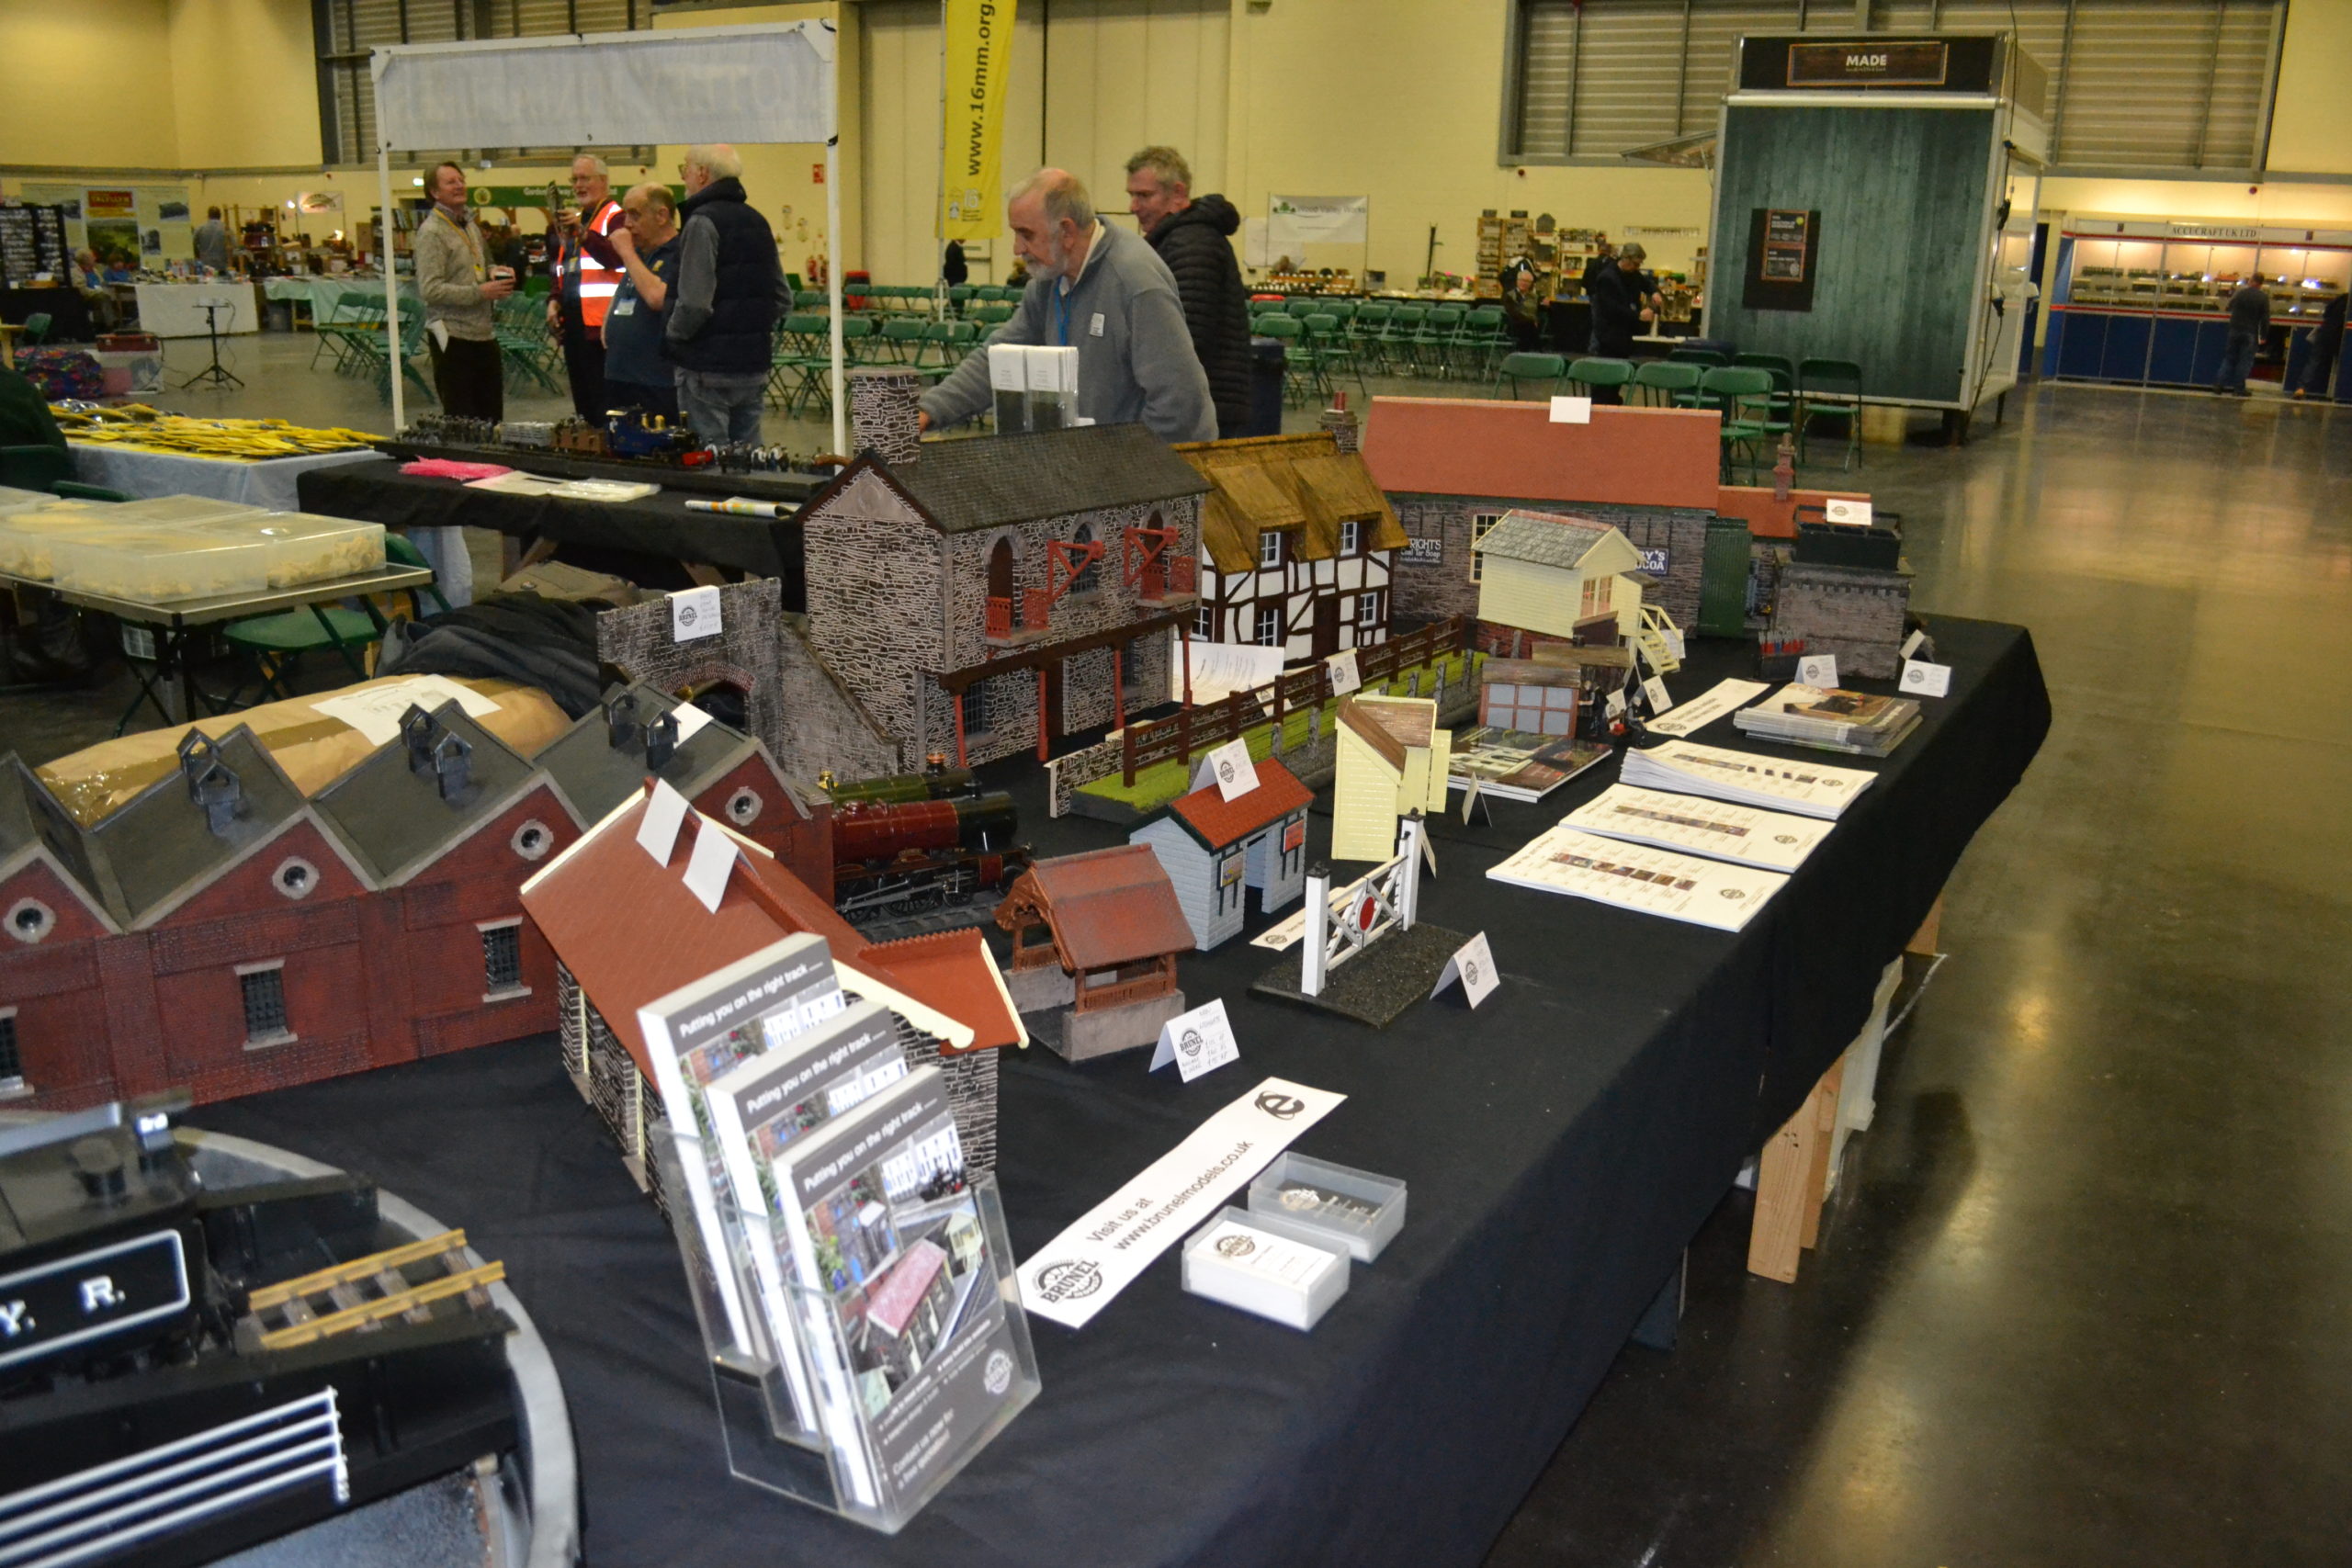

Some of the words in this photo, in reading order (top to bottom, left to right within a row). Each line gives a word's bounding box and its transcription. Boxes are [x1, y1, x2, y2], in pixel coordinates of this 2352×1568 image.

[1846, 54, 1887, 67] MADE
[2172, 227, 2224, 237] ACCUCRAFT
[2225, 228, 2239, 237] UK
[2239, 229, 2256, 238] LTD
[1425, 550, 1441, 558] Soap
[679, 1013, 716, 1038] Putting
[715, 1002, 733, 1022] you
[734, 995, 748, 1010] on
[746, 988, 763, 1003] the
[763, 976, 785, 994] right
[1180, 1035, 1204, 1053] BRUNEL
[746, 1087, 782, 1114] Putting
[781, 1077, 799, 1098] you
[799, 1068, 813, 1083] on
[811, 1059, 828, 1076] the
[829, 1046, 849, 1066] right
[804, 1162, 838, 1192] Putting
[837, 1150, 854, 1172] you
[854, 1142, 867, 1157] on
[866, 1131, 881, 1147] the
[881, 1116, 901, 1138] right
[1114, 1140, 1253, 1252] www.brunelmodels.co.uk
[1087, 1220, 1117, 1243] Visit
[1122, 1209, 1139, 1224] us
[1138, 1198, 1154, 1211] at
[81, 1275, 126, 1314] R.
[1041, 1258, 1100, 1304] BRUNEL
